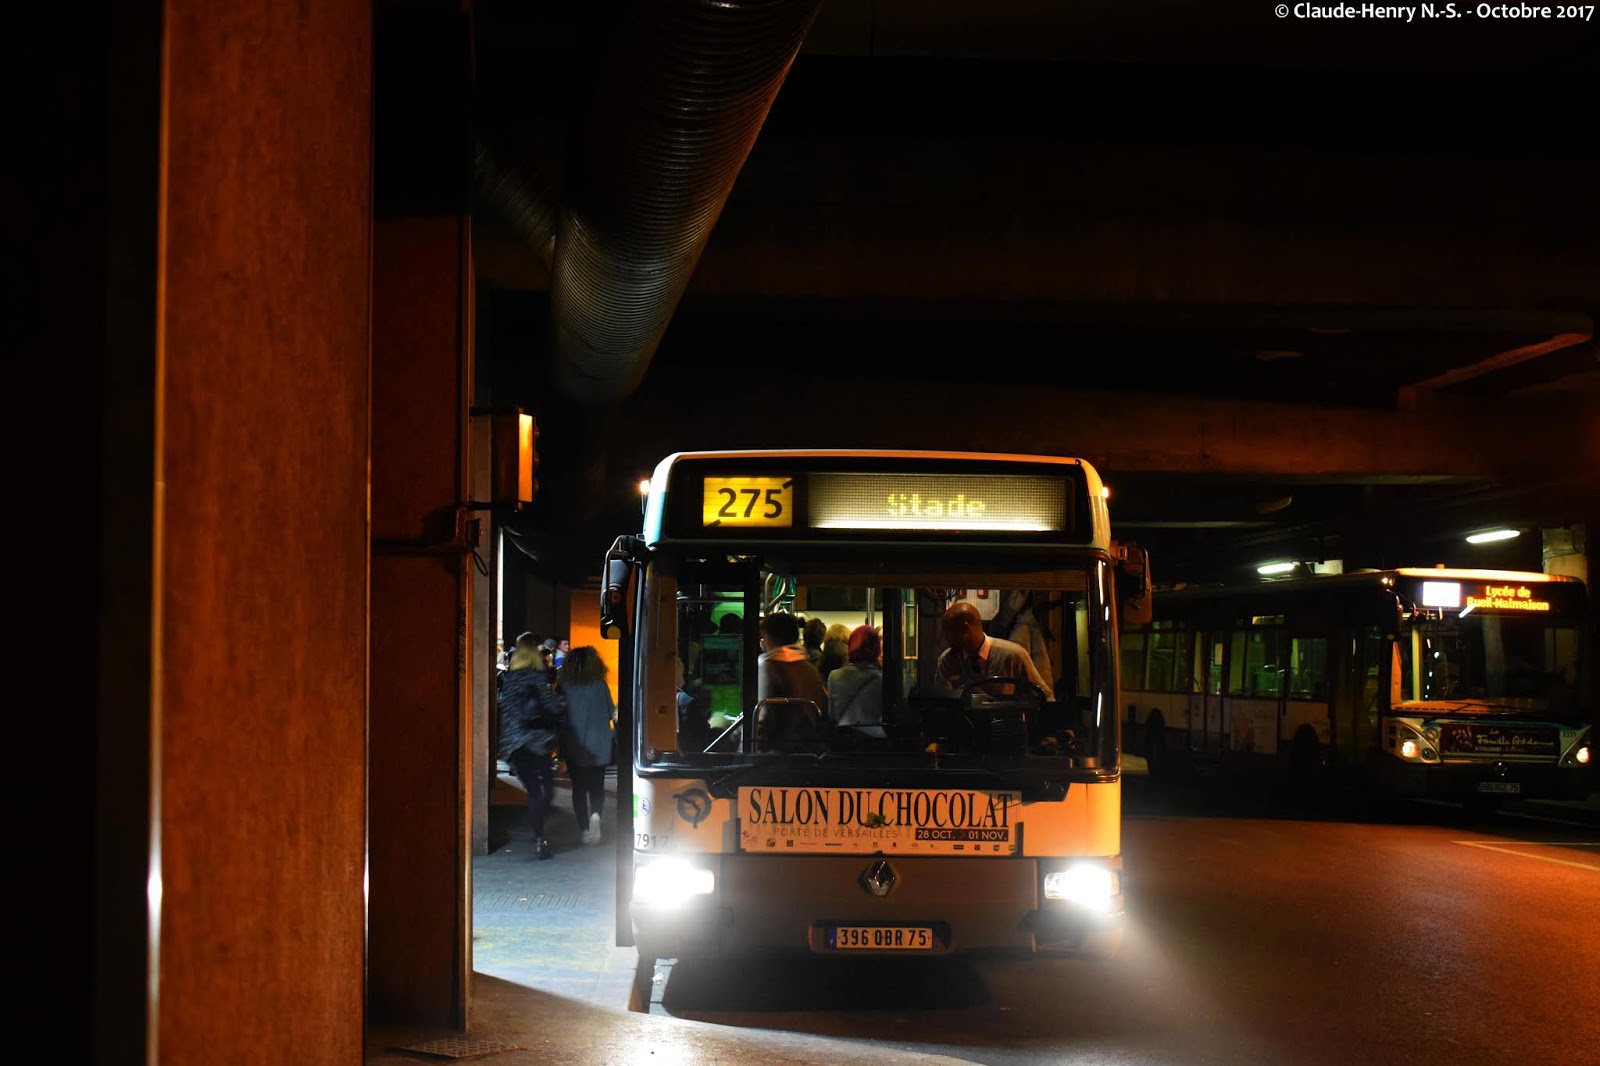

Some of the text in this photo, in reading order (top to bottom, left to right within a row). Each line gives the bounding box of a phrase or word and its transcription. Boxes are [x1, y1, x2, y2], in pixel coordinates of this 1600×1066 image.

[717, 488, 783, 519] 275
[887, 493, 987, 518] Stade
[1485, 585, 1531, 599] Lycée de
[749, 787, 1013, 828] SALON DU CHOCOLAT
[773, 827, 898, 839] PORTE DE VERSAILLES
[917, 829, 1007, 841] 28 OCT. 01 NOV.
[841, 929, 869, 946] 396
[908, 929, 927, 946] 75
